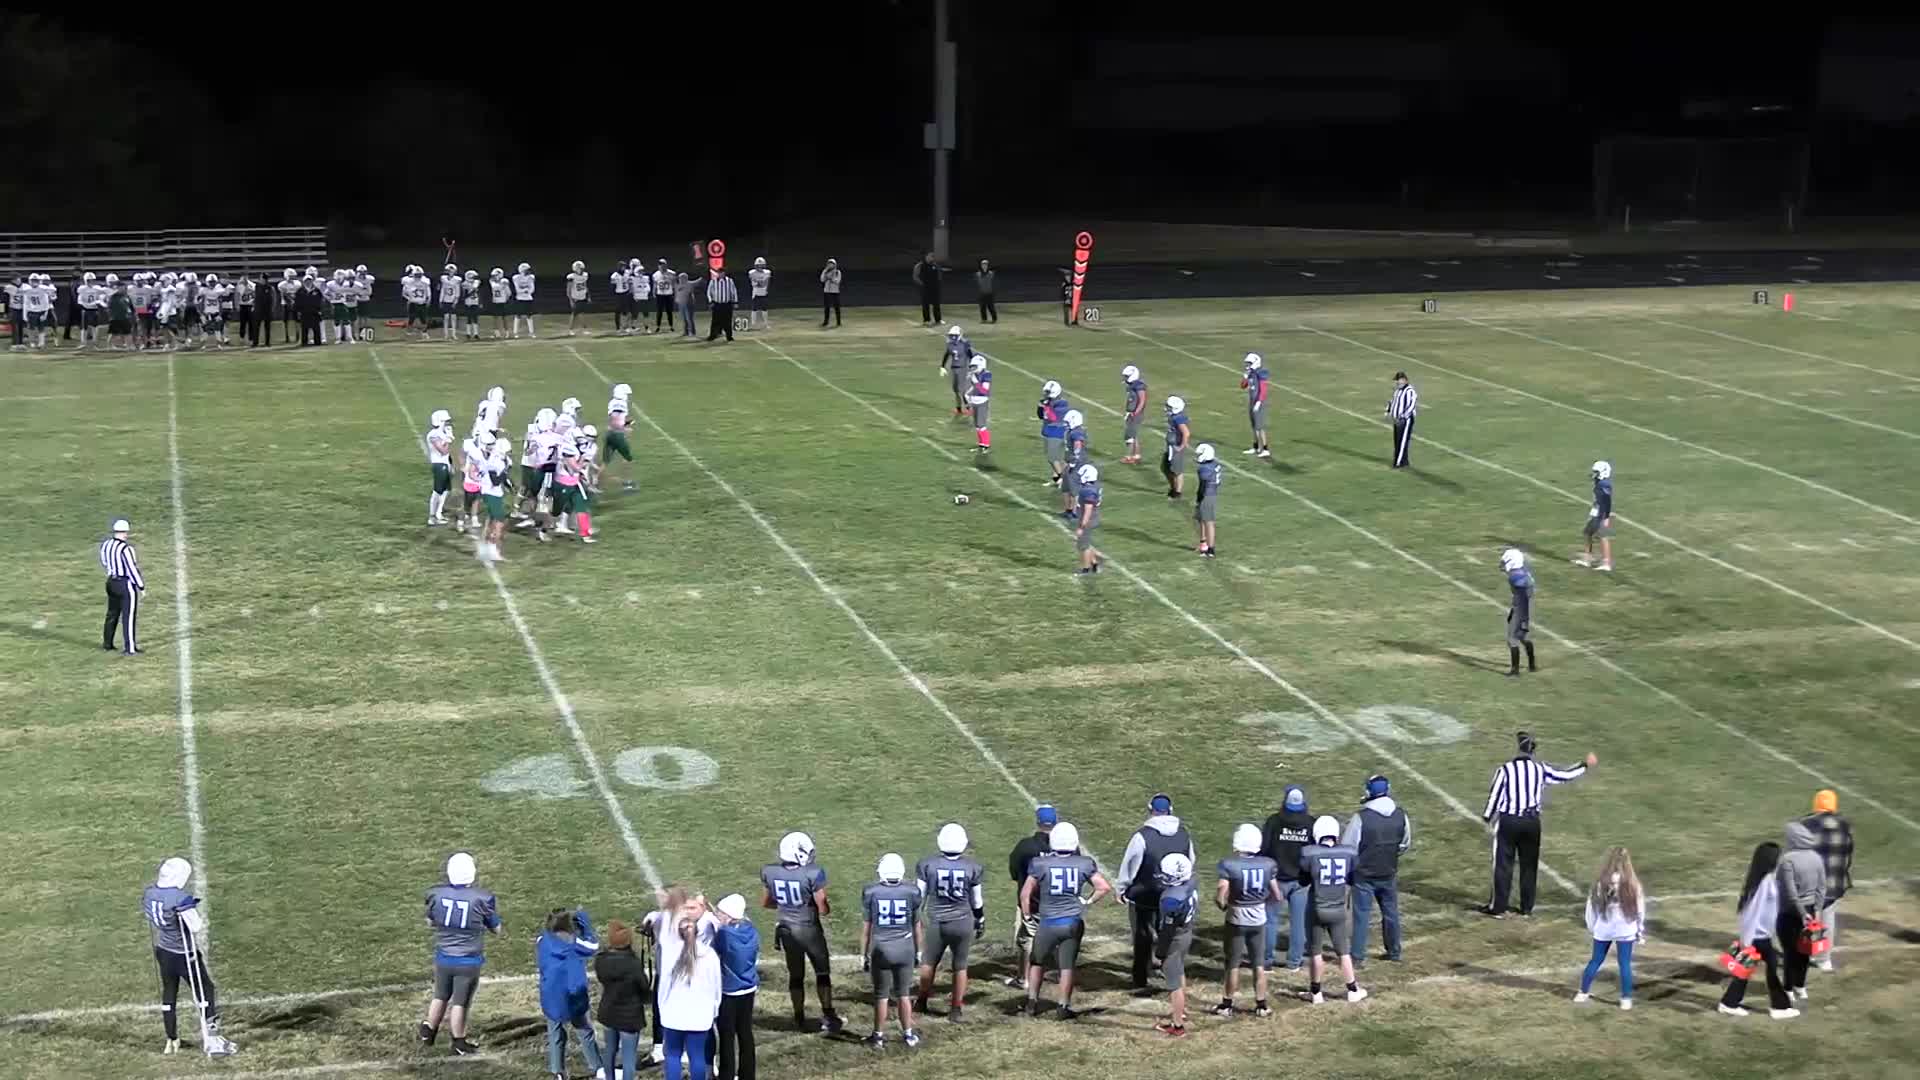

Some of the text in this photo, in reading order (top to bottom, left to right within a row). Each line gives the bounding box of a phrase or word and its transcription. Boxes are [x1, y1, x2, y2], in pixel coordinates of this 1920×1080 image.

[1085, 308, 1099, 321] 20
[1424, 300, 1435, 312] 10
[360, 327, 374, 340] 40
[735, 318, 749, 331] 30
[1232, 704, 1473, 753] 30
[480, 745, 720, 800] 40
[937, 869, 965, 897] 55
[1050, 867, 1079, 895] 54
[1242, 868, 1264, 895] 14
[1319, 858, 1347, 886] 23
[774, 879, 803, 905] 50
[151, 900, 167, 926] 11
[441, 898, 469, 929] 77
[877, 899, 907, 925] 85
